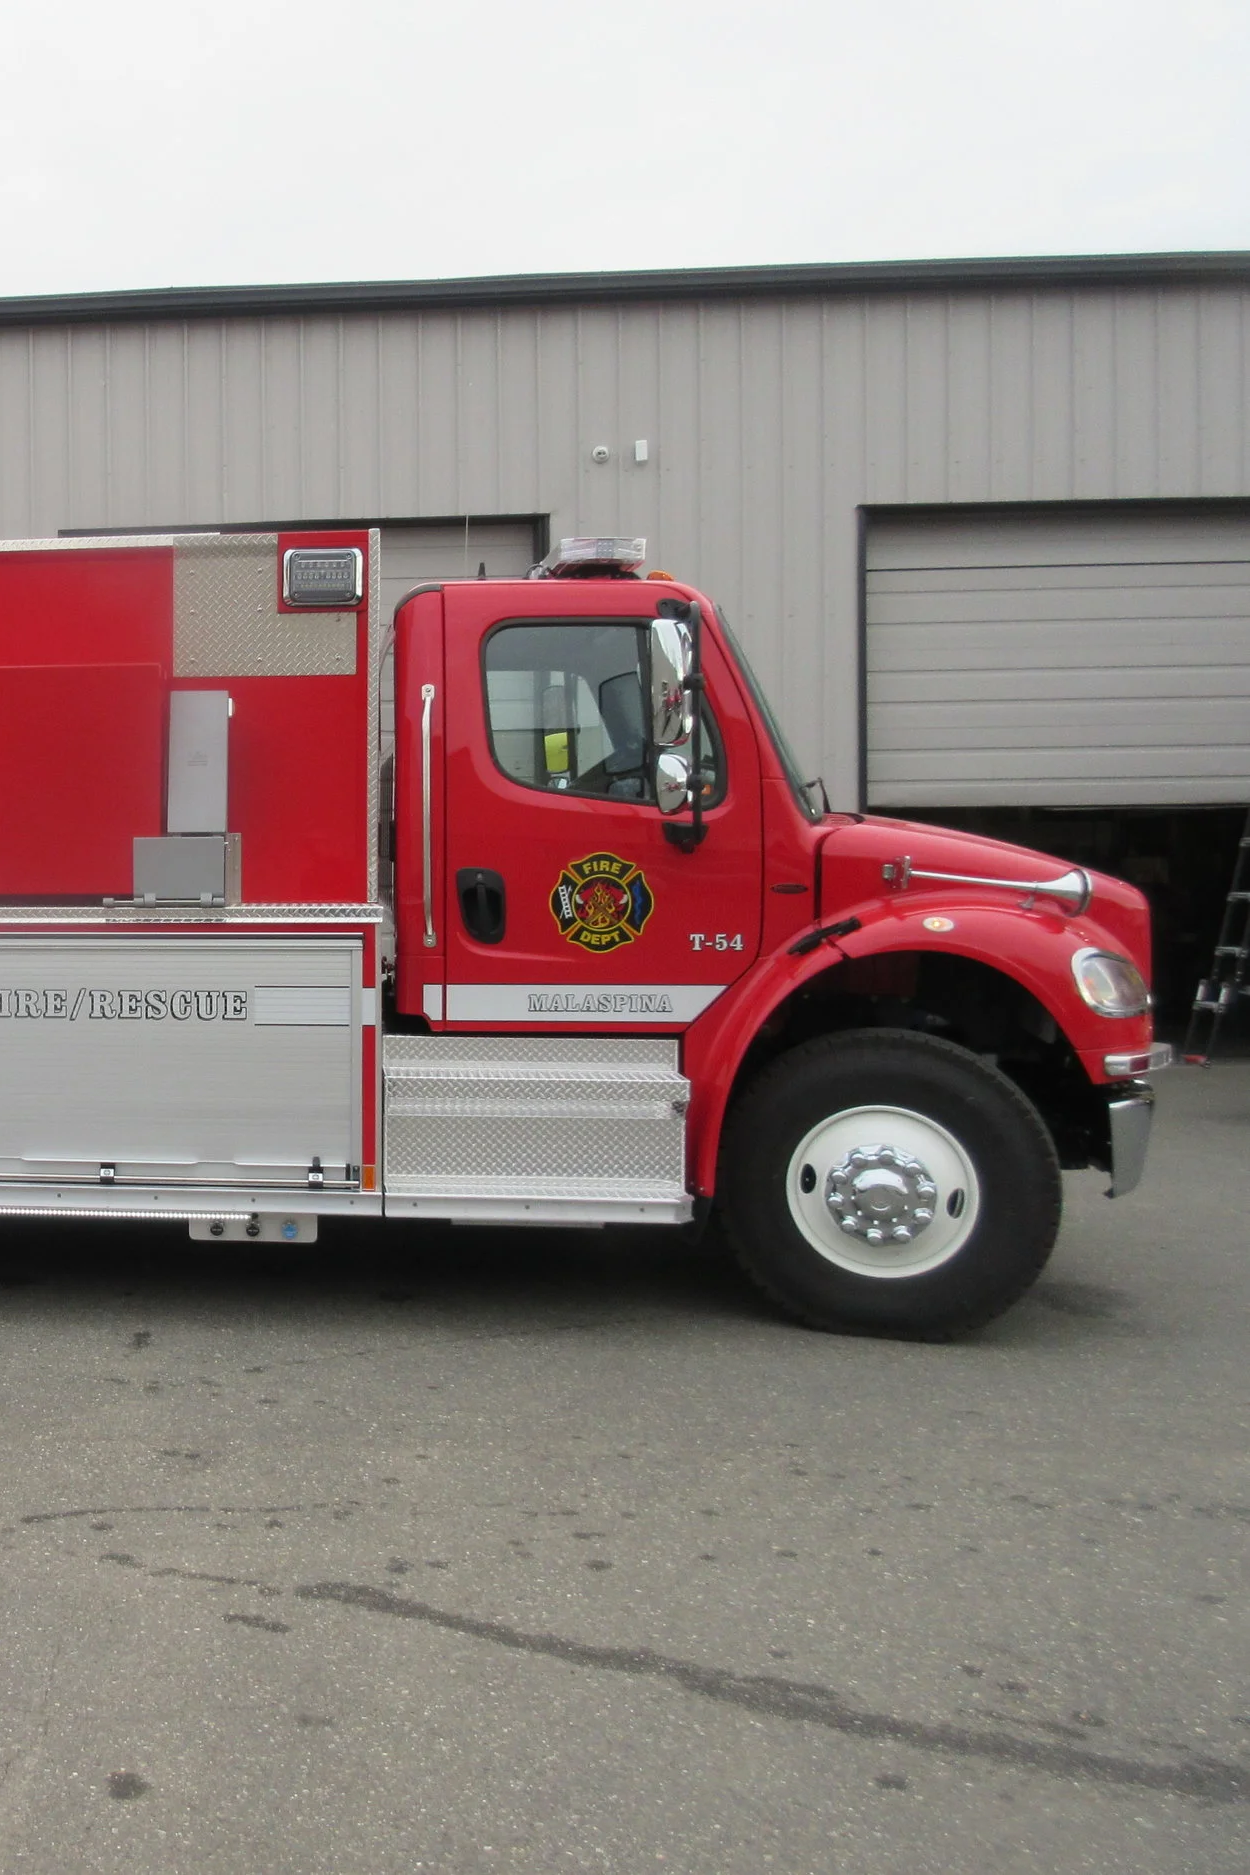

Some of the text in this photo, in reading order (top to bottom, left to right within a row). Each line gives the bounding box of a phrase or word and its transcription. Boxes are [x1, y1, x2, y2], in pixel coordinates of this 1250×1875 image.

[582, 860, 622, 874] FIRE
[579, 930, 620, 945] DEPT
[689, 933, 744, 951] T-54
[528, 993, 673, 1012] MALASPINA
